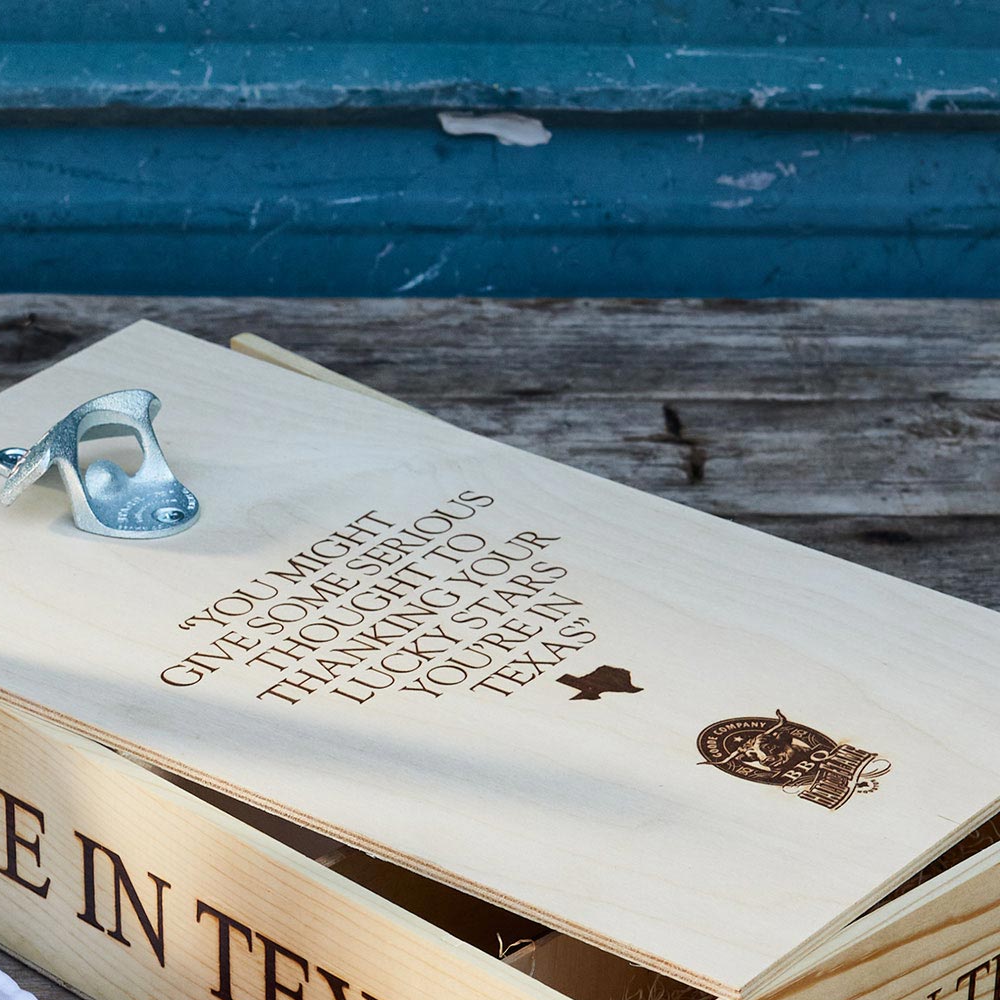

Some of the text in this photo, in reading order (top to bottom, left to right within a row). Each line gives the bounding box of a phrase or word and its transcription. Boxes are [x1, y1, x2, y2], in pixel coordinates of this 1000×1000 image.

[160, 490, 494, 686] GIVE SOME SERIOUS
[245, 534, 486, 671] THOUGHT TO
[265, 510, 396, 584] MIGHT
[256, 531, 561, 705] THANKING YOUR
[330, 562, 567, 704] LUCKY STARS
[398, 592, 583, 698] YOU’RE IN
[707, 722, 766, 757] GOODE COMPANY
[782, 750, 830, 782] BBQ
[74, 830, 172, 968] IN
